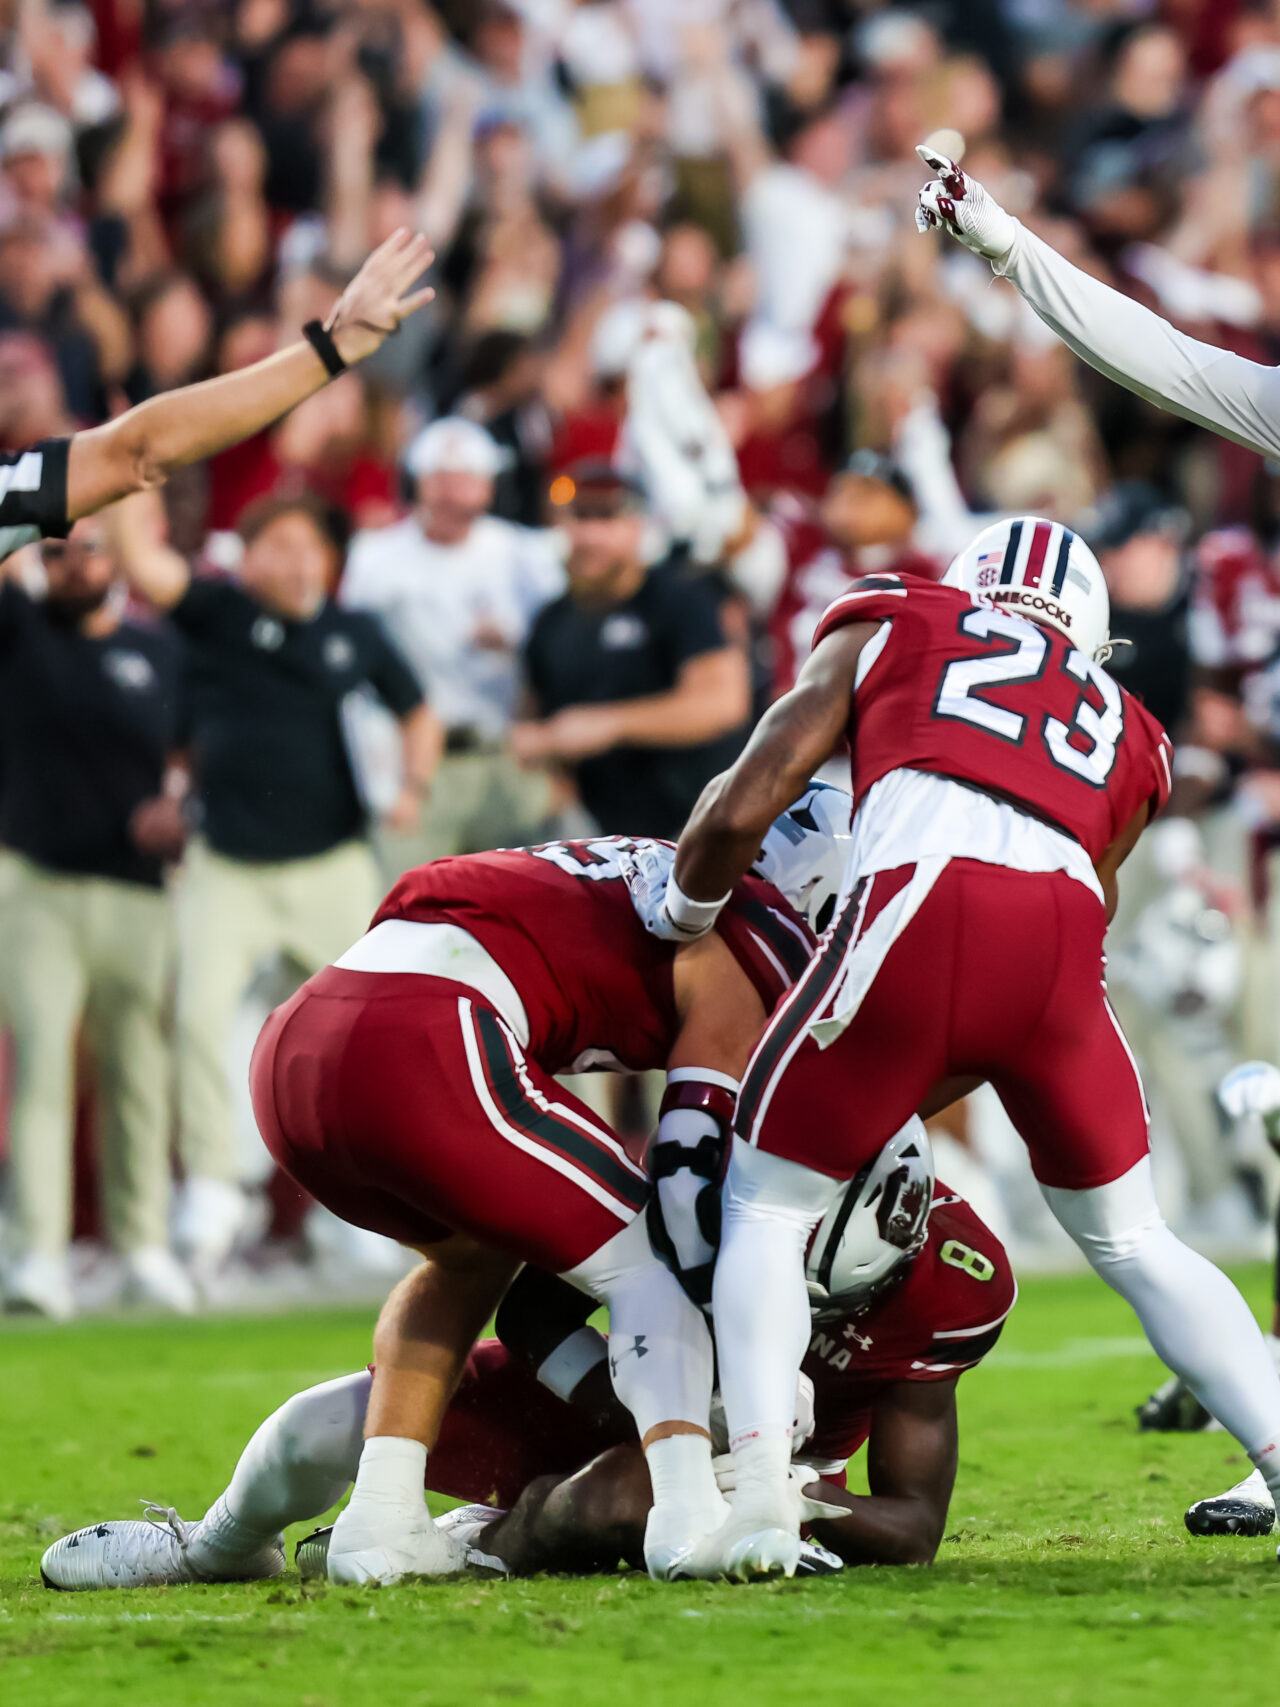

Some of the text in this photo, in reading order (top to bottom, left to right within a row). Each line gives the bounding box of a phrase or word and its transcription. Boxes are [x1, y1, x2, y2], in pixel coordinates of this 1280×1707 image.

[984, 591, 1073, 628] AMECOCKS
[931, 607, 1126, 791] 23
[939, 1239, 995, 1281] 8
